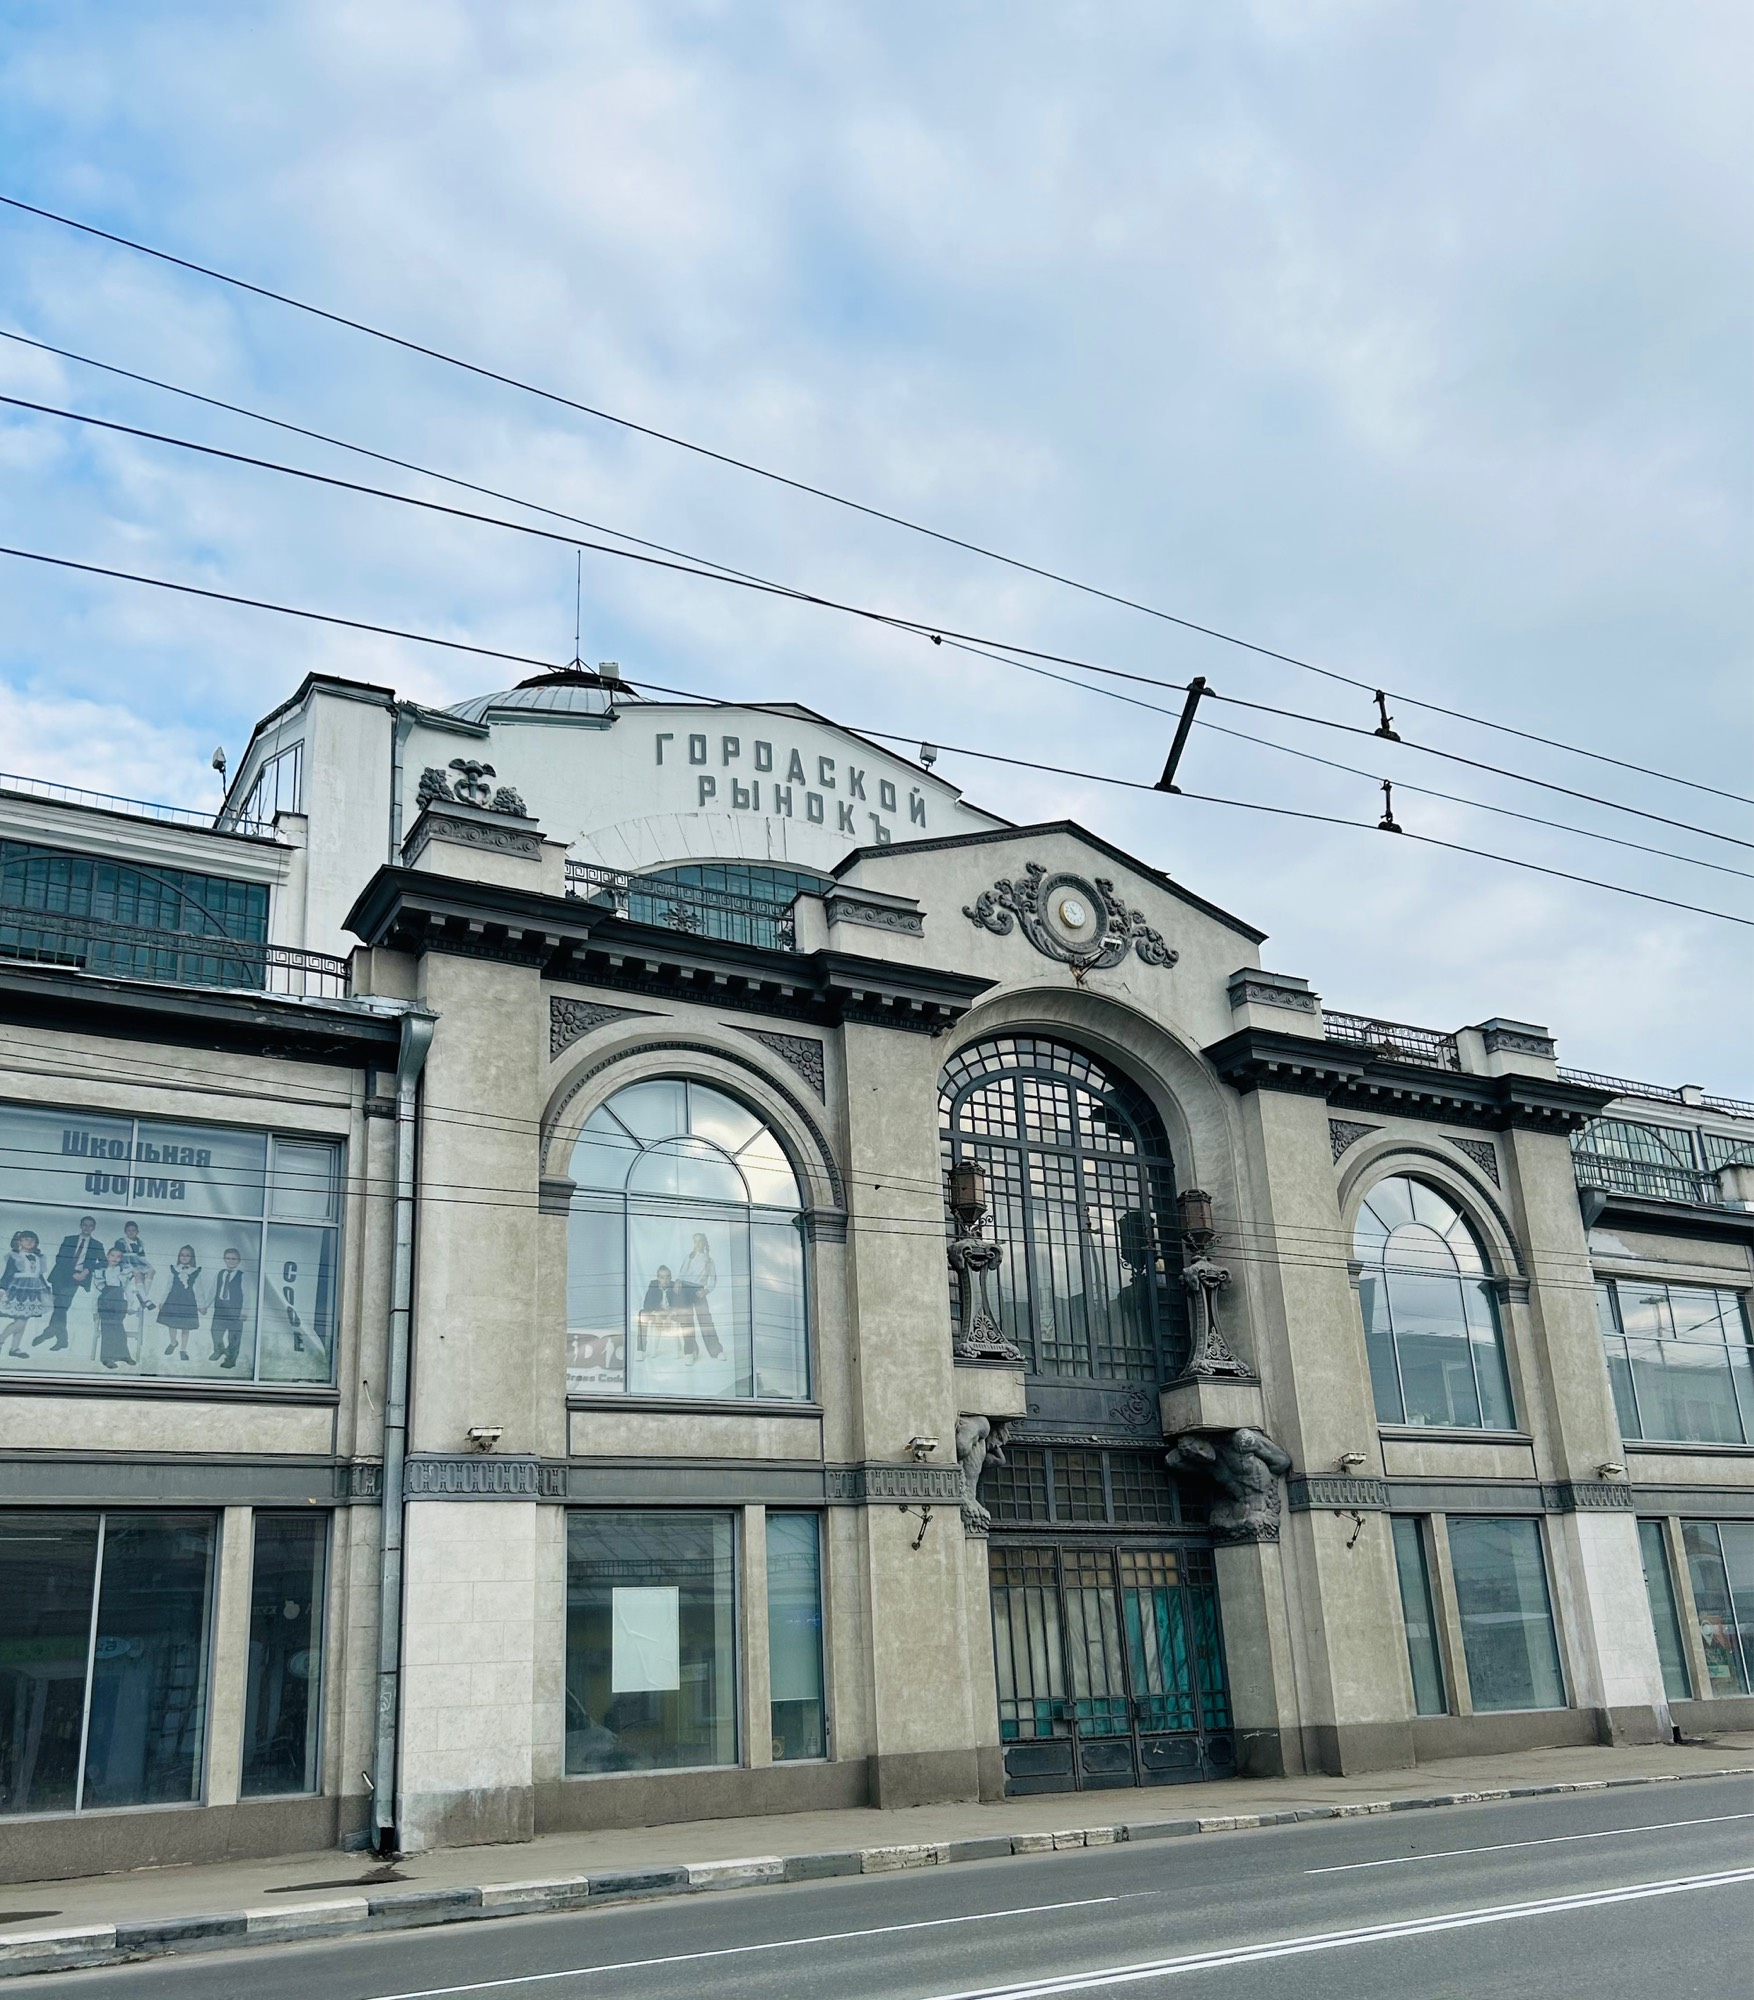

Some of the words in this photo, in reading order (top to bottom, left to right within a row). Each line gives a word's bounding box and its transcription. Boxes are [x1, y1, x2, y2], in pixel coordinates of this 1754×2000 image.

[656, 733, 926, 828] ГОРОДСКОЙ
[698, 775, 891, 845] РЫНОКЪ
[62, 1130, 212, 1167] Школьная
[85, 1170, 186, 1200] форма
[283, 1261, 305, 1352] CODE
